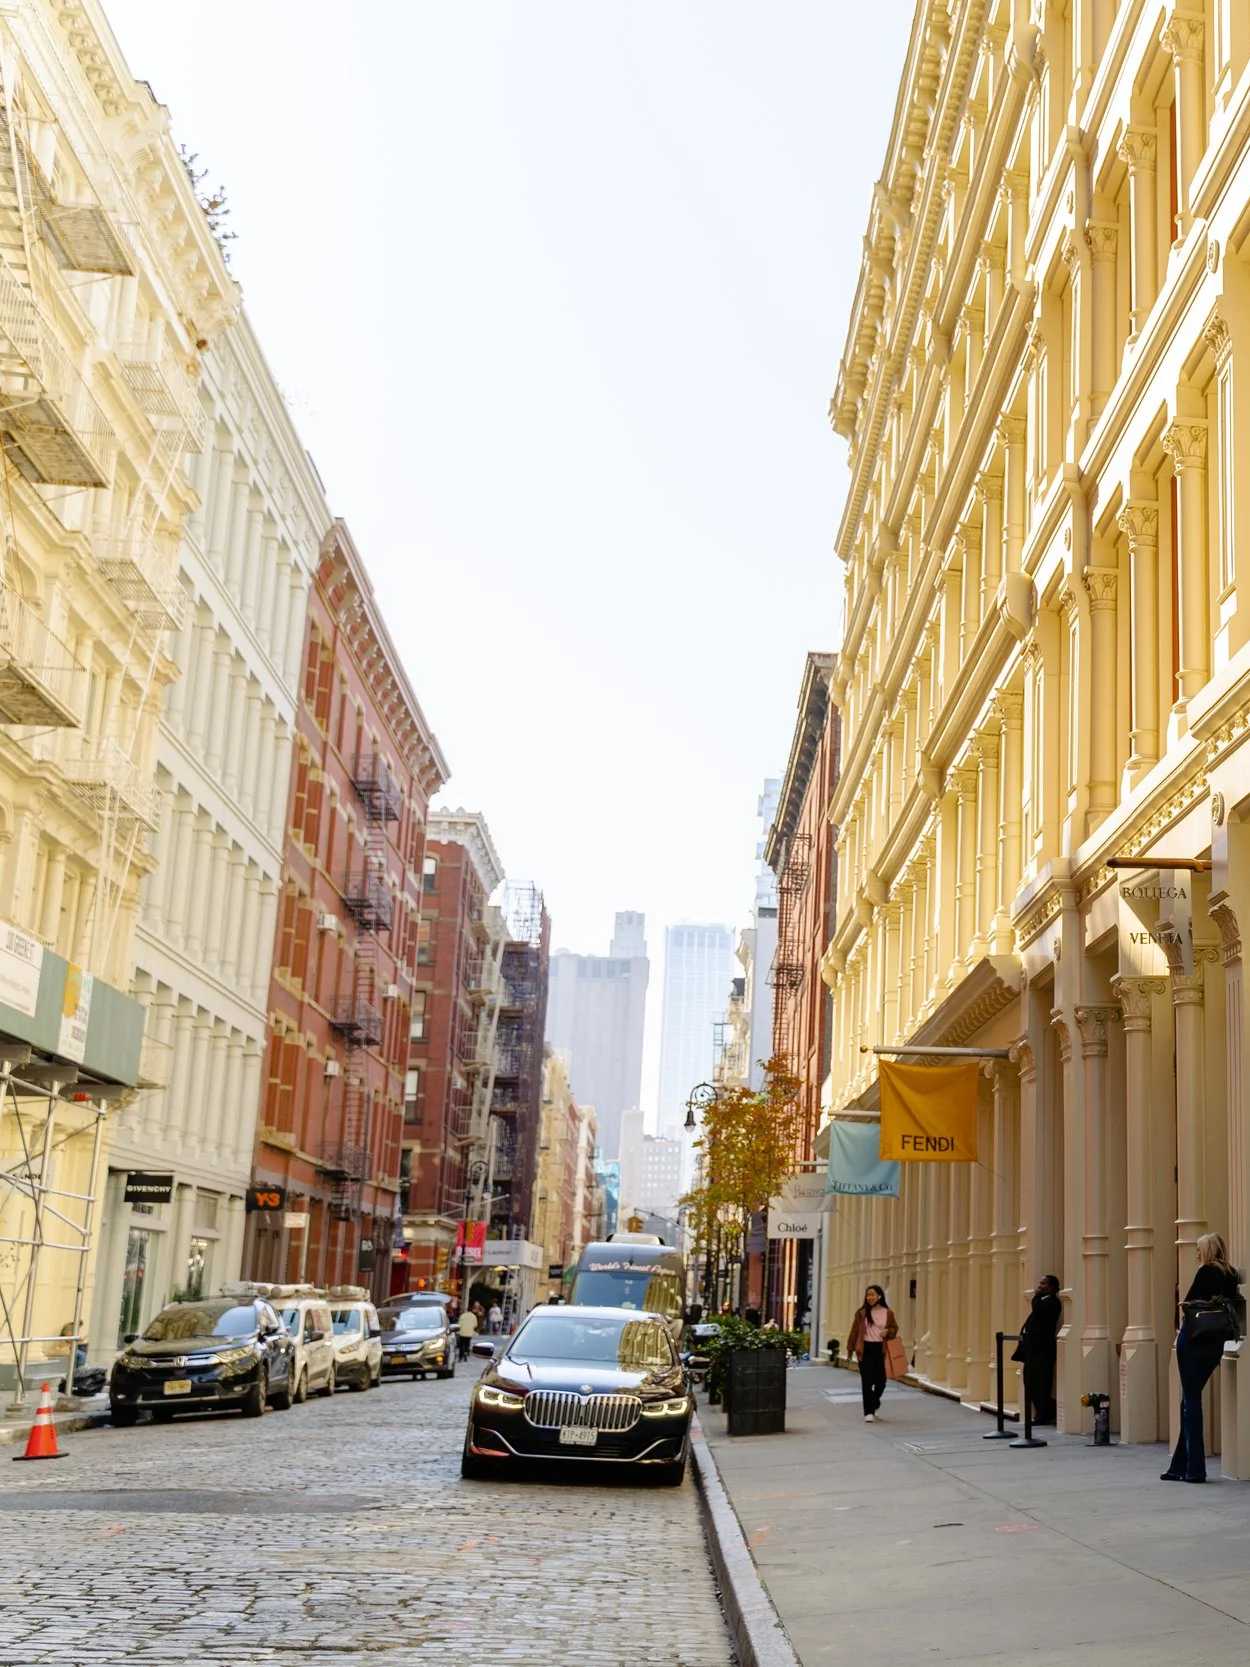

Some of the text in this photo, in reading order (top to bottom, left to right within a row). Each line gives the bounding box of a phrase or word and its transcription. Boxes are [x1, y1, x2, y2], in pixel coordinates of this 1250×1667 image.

[1122, 886, 1187, 899] BOTTEGA
[1129, 932, 1183, 945] VENETA
[901, 1134, 954, 1152] FENDI
[126, 1184, 171, 1193] GIVENCHY
[777, 1222, 808, 1233] Chloé
